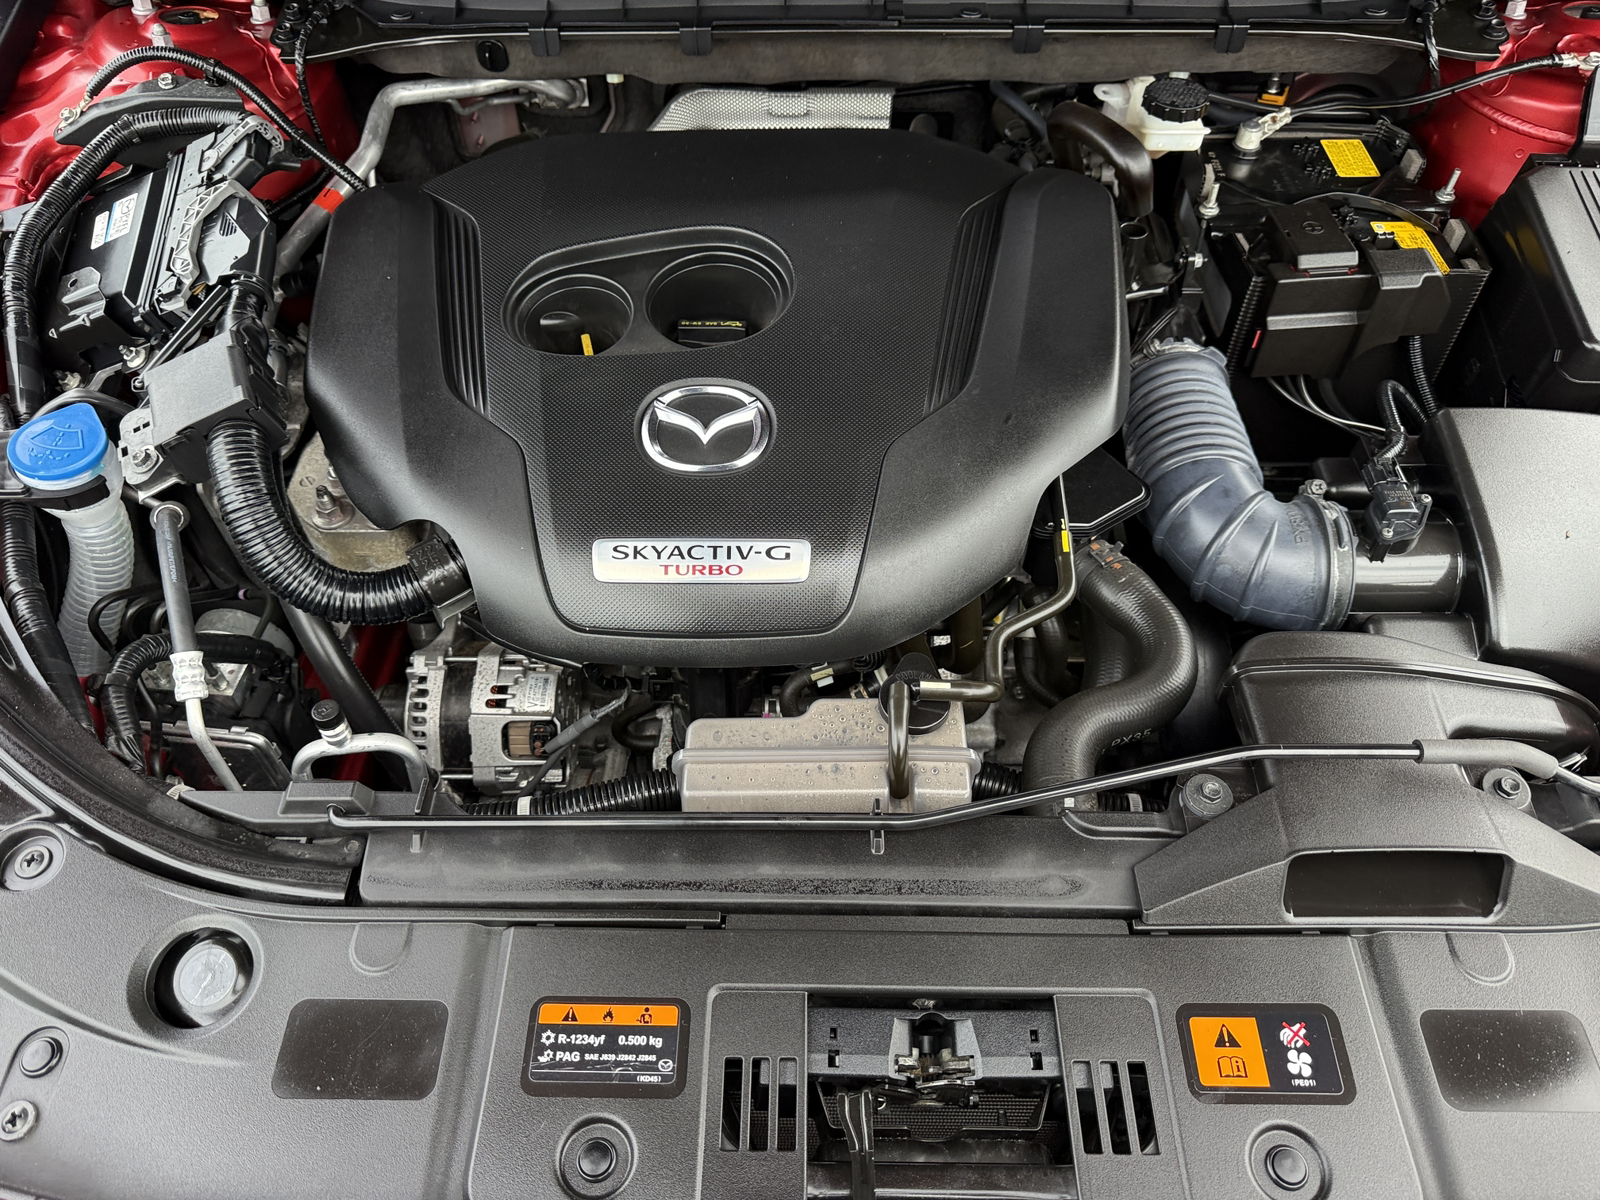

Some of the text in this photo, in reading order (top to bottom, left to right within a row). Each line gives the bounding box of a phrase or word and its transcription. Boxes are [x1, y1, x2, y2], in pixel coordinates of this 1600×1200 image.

[611, 544, 791, 561] SKYACTIV-G
[659, 564, 744, 576] TURBO
[895, 670, 938, 681] COOLAN
[558, 1034, 663, 1048] R-1234yf 0.500 kg
[556, 1051, 580, 1061] PAG
